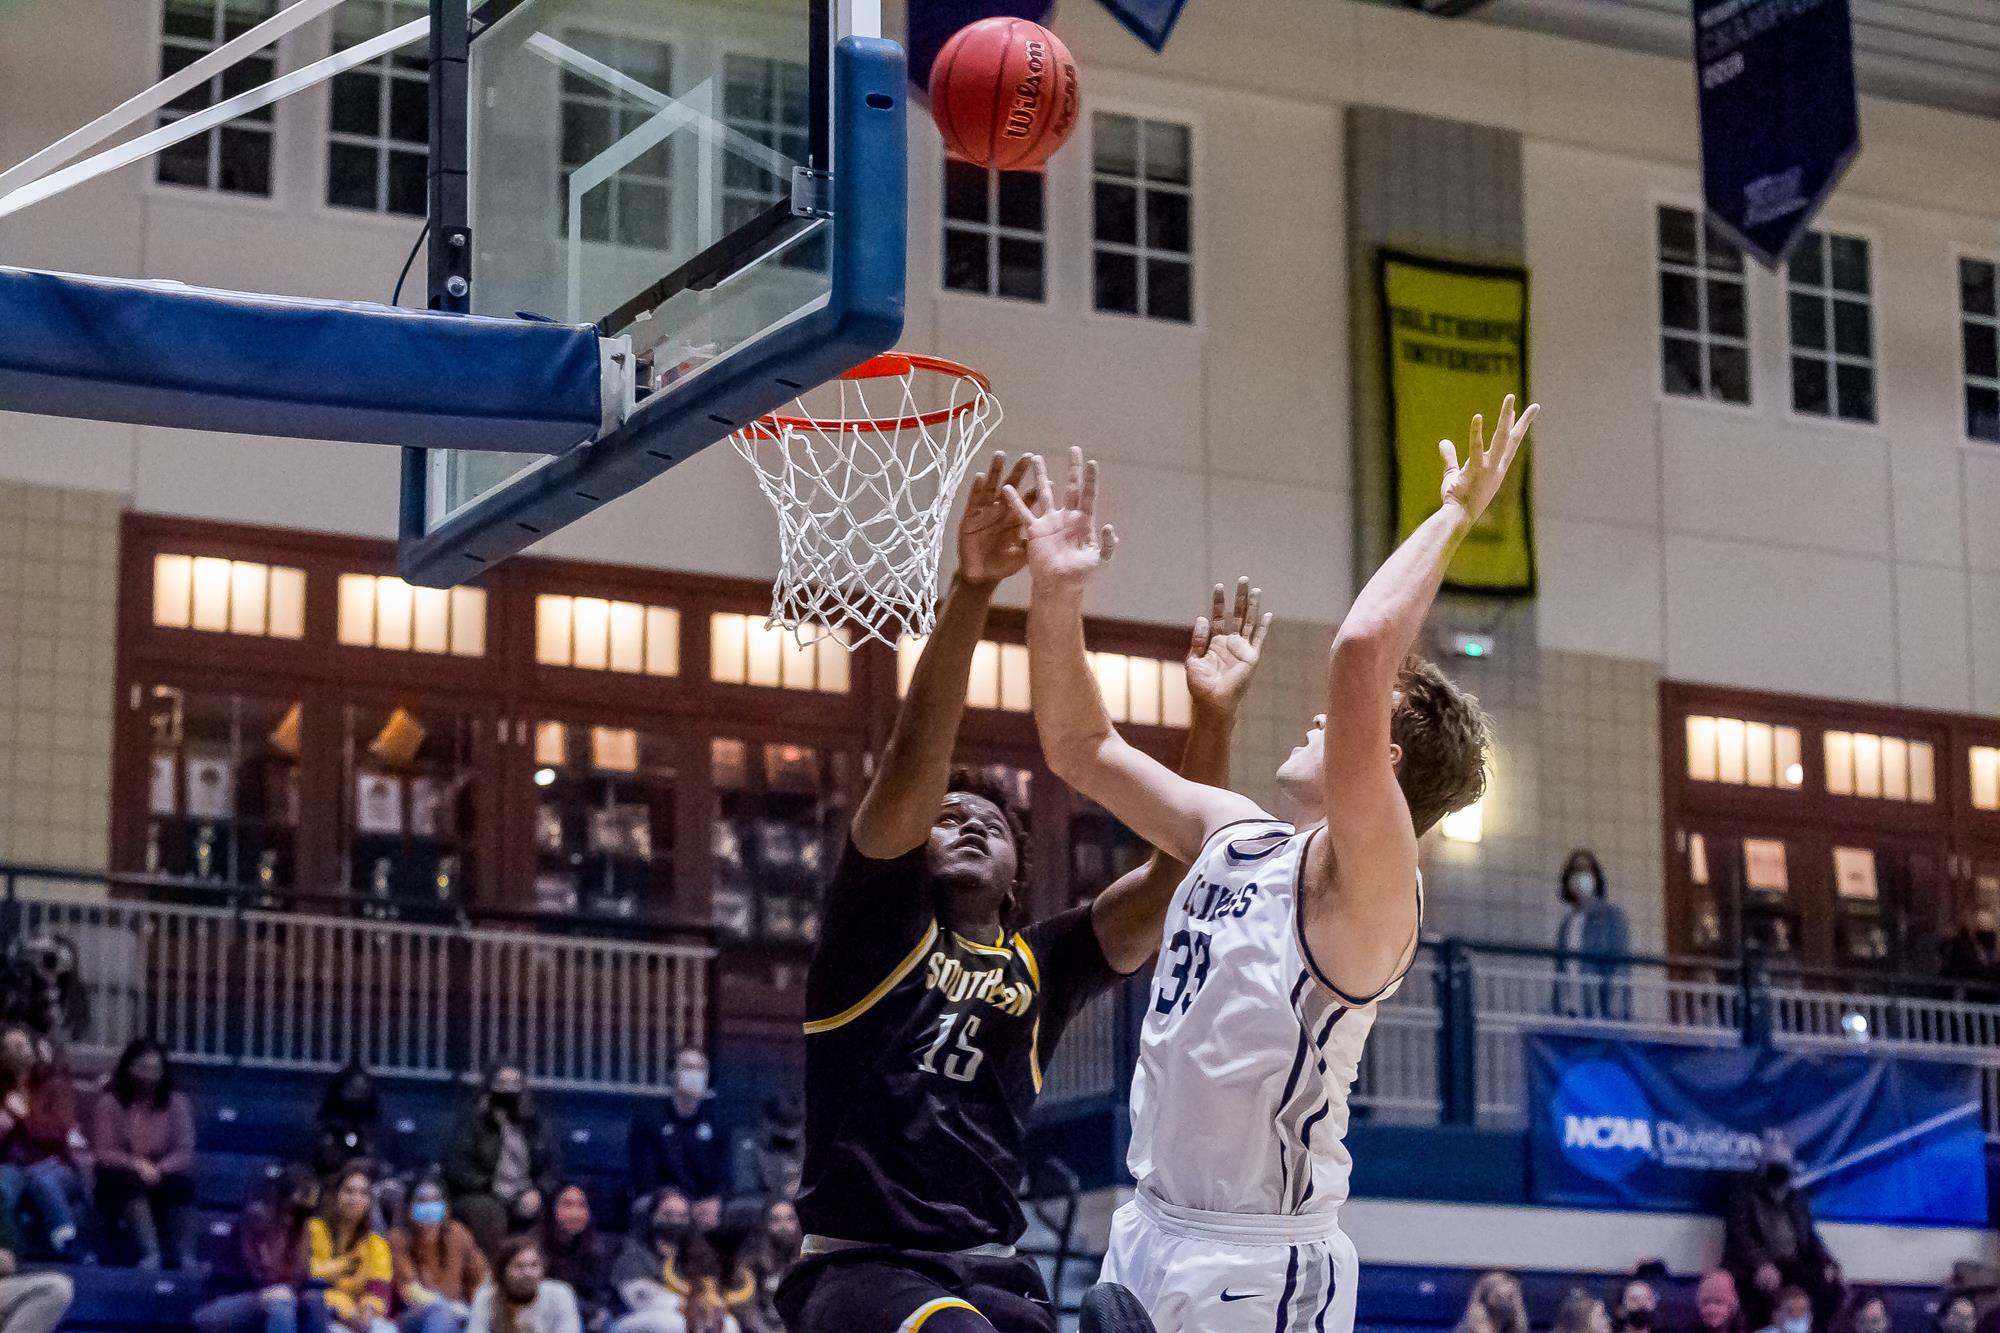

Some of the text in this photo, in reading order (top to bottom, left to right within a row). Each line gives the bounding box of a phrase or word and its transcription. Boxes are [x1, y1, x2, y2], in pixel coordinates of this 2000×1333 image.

[1003, 40, 1045, 139] Wilson
[917, 1012, 984, 1082] 15
[1563, 1115, 1653, 1152] NCAA
